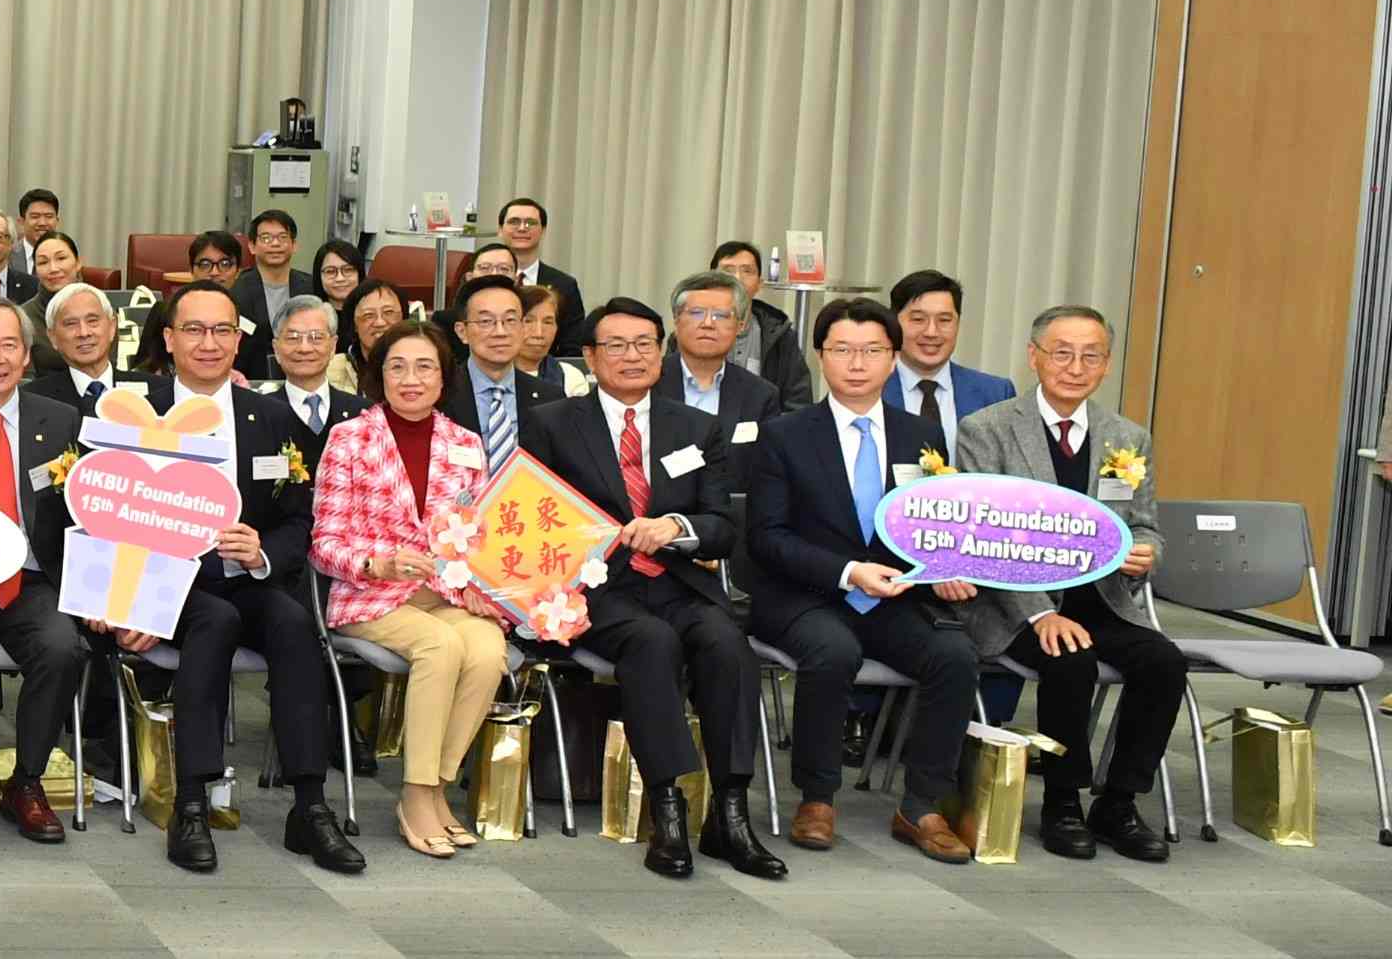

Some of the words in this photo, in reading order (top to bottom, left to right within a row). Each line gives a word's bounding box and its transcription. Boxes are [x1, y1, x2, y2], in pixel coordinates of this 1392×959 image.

[78, 467, 130, 493] HKBU
[132, 480, 226, 517] Foundation
[81, 494, 114, 513] 15th
[117, 504, 220, 545] Anniversary
[496, 497, 568, 537] 萬象
[903, 496, 970, 523] HKBU
[975, 503, 1097, 537] Foundation
[501, 541, 572, 580] 更新
[912, 528, 955, 552] 15th
[960, 534, 1093, 572] Anniversary
